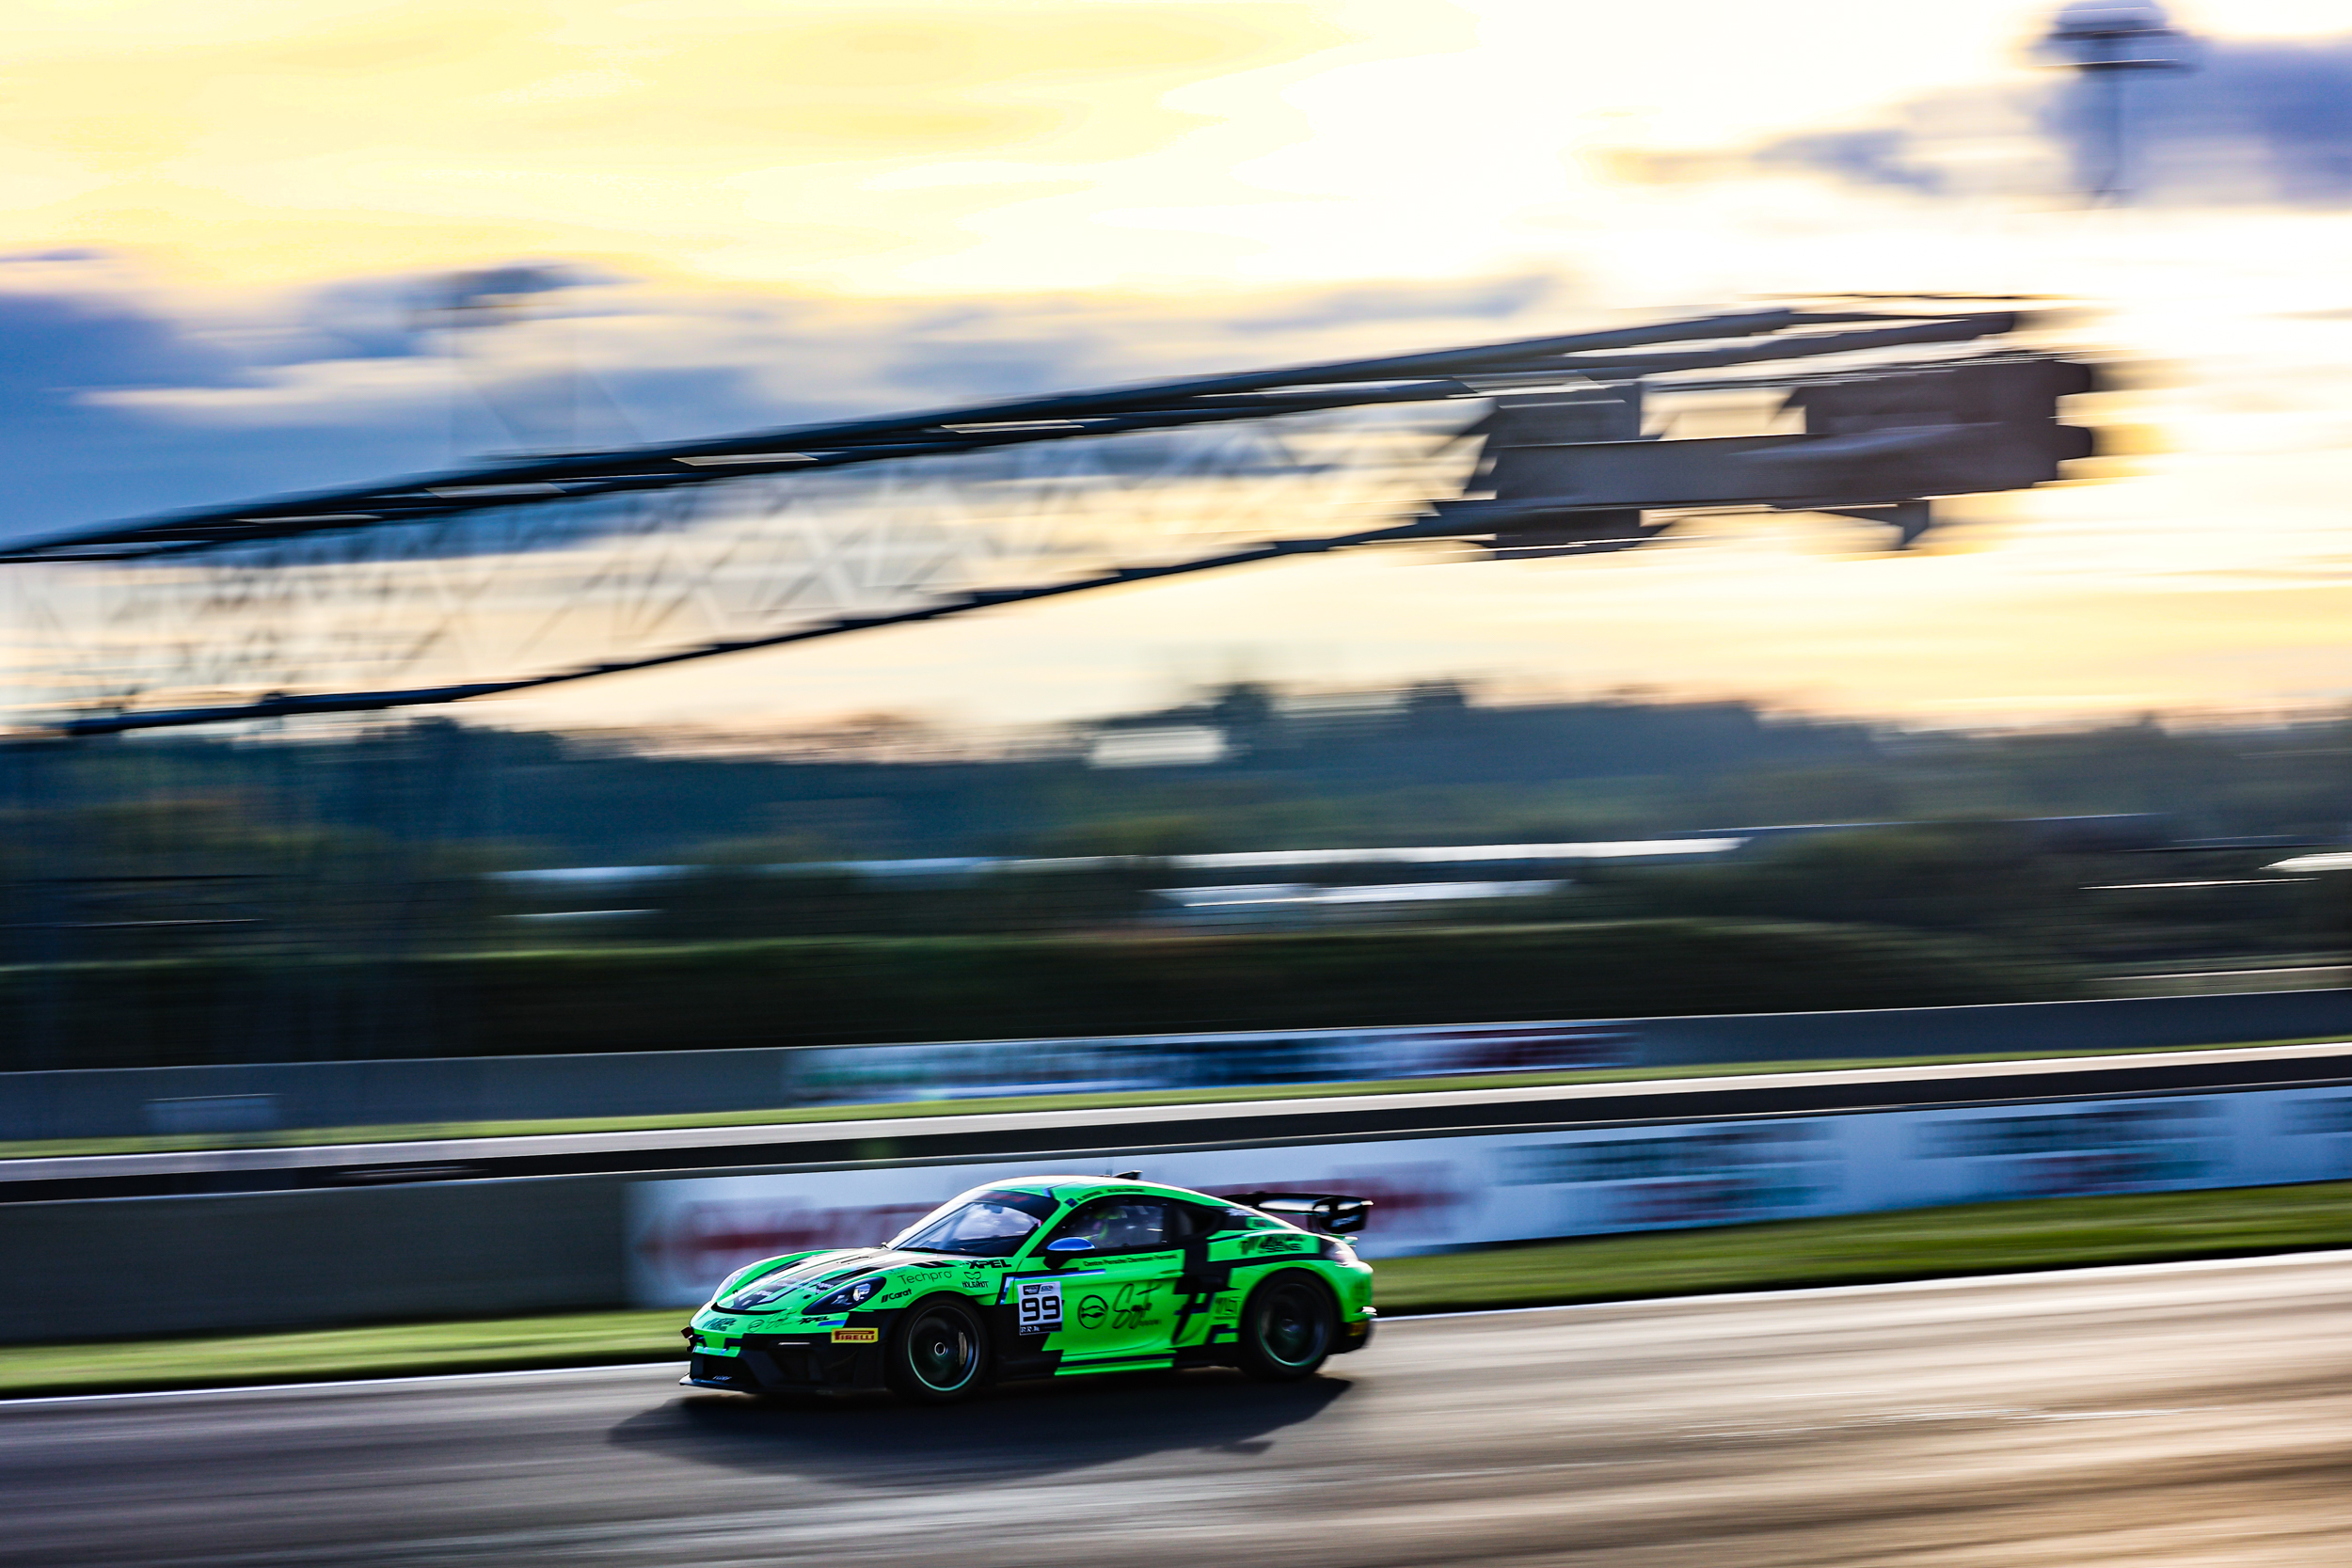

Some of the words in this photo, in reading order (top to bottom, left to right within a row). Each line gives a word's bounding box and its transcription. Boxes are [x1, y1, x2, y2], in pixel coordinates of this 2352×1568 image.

[968, 1259, 1012, 1269] XPEL
[897, 1270, 952, 1285] Techpro
[1022, 1295, 1060, 1323] 99
[834, 1330, 875, 1340] PIRELLI
